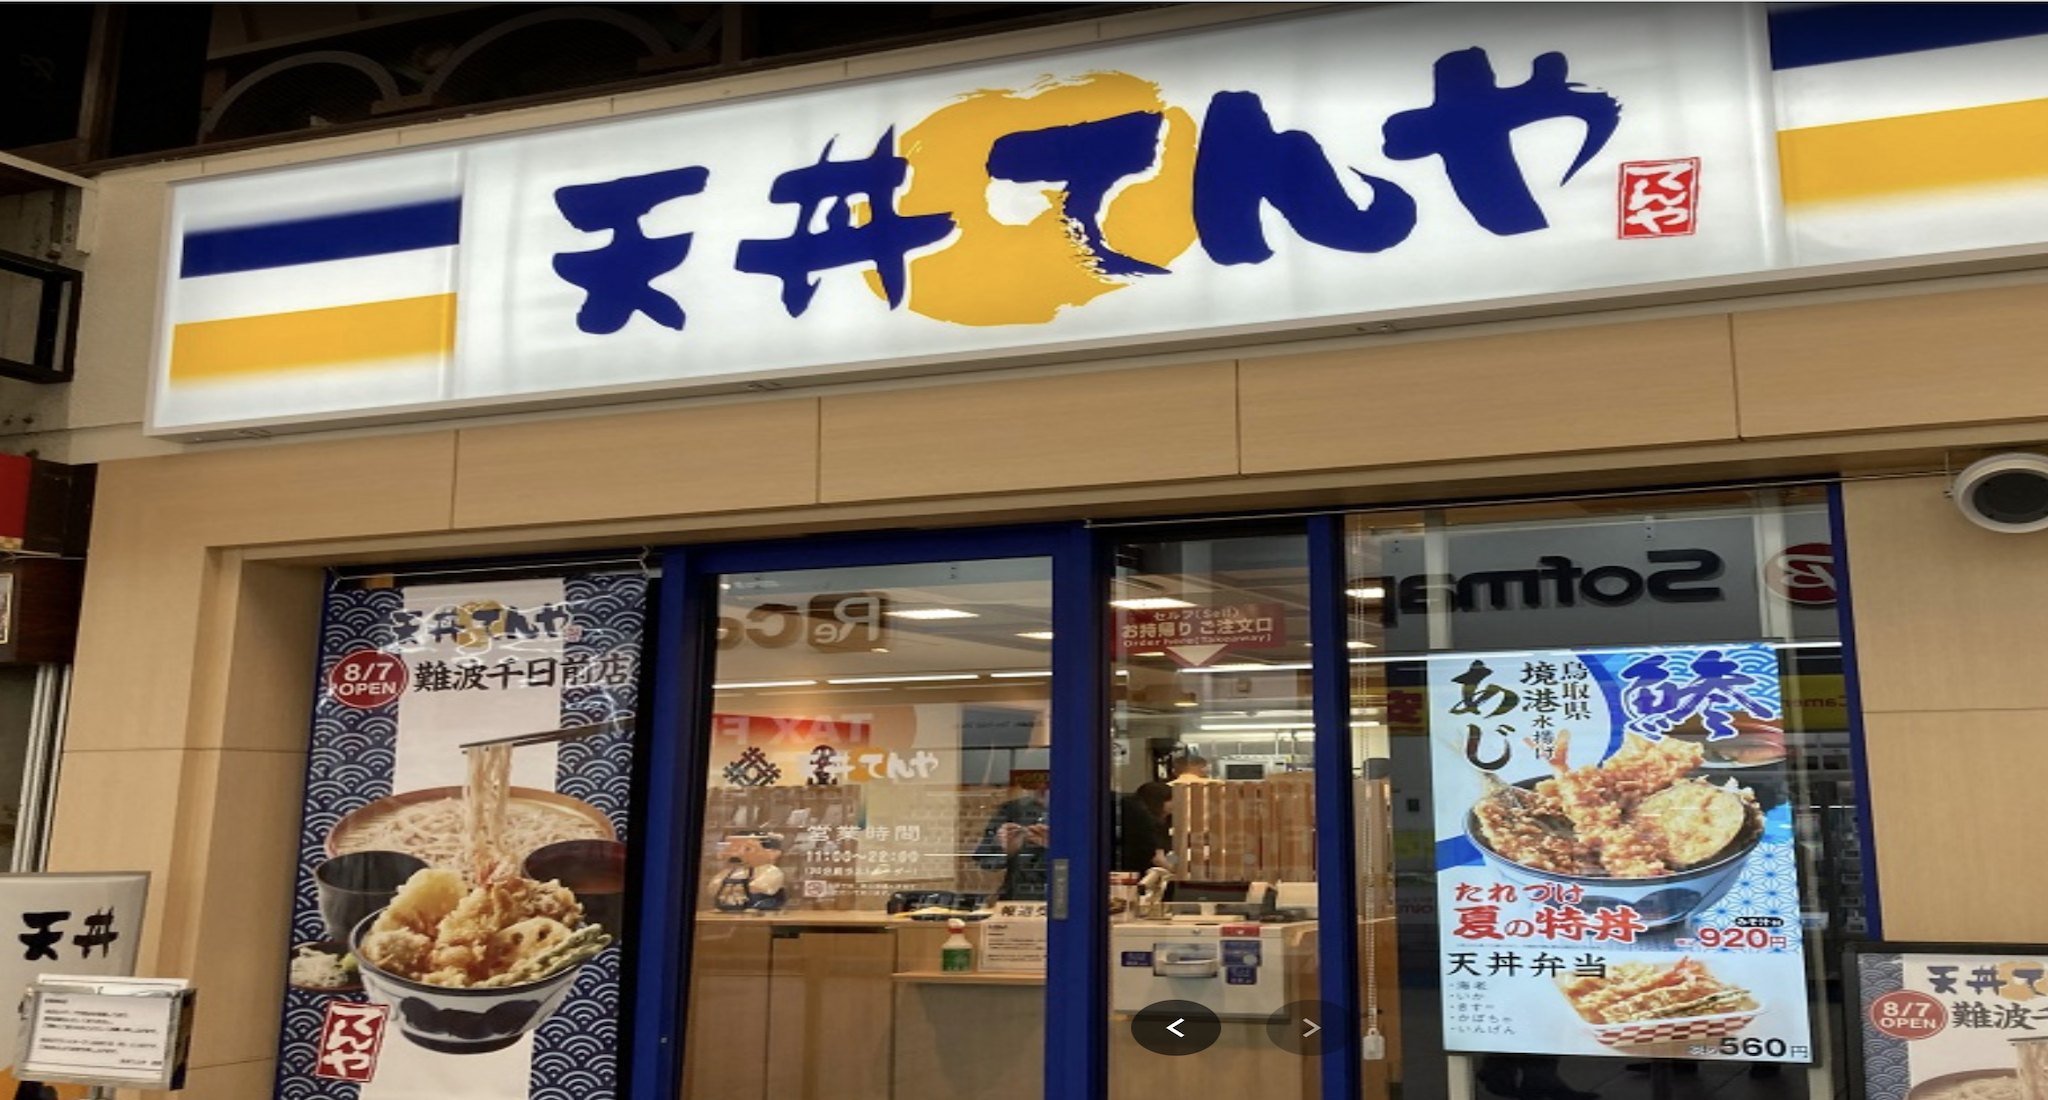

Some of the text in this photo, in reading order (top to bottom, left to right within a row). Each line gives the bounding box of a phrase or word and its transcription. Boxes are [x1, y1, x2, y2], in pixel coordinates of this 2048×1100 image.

[552, 46, 1622, 334] 天丼てんや
[1624, 161, 1695, 235] てんや
[343, 662, 394, 681] 8/7
[413, 651, 631, 692] 難波千日前店
[338, 682, 397, 696] OPEN
[1560, 661, 1592, 721] 鳥取県
[1449, 659, 1520, 771] あじ
[806, 826, 922, 842] 営業時間
[1454, 882, 1586, 904] たれづけ
[18, 905, 119, 961] 天丼
[1453, 905, 1648, 943] 夏の特丼
[1699, 928, 1787, 949] 920円
[1447, 951, 1607, 979] 天丼弁当
[1882, 1001, 1932, 1017] 8/7
[1880, 1018, 1937, 1029] OPEN
[322, 1004, 384, 1077] てんや
[1719, 1037, 1809, 1059] 560円
